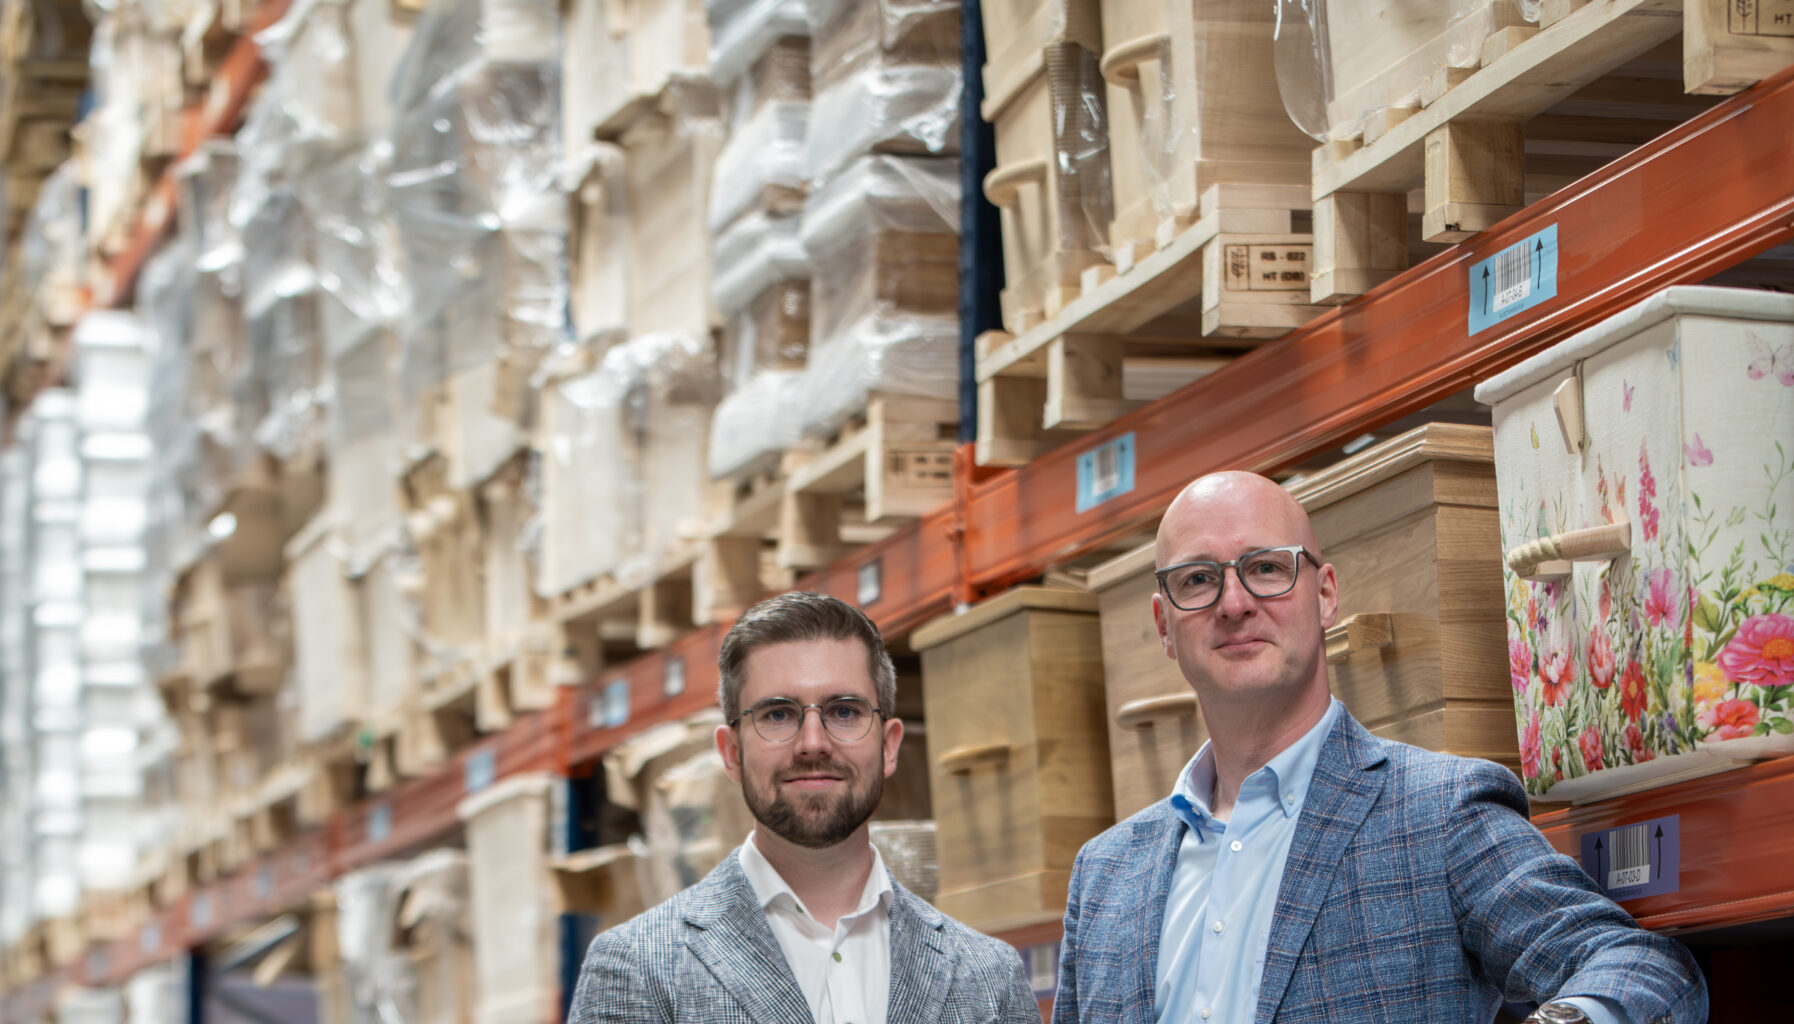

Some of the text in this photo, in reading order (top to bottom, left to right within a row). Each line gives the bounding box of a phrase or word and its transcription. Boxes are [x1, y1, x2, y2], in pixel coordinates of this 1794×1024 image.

[1774, 13, 1792, 25] HT
[1262, 271, 1277, 281] HT
[1616, 869, 1641, 885] A-07-03-D
